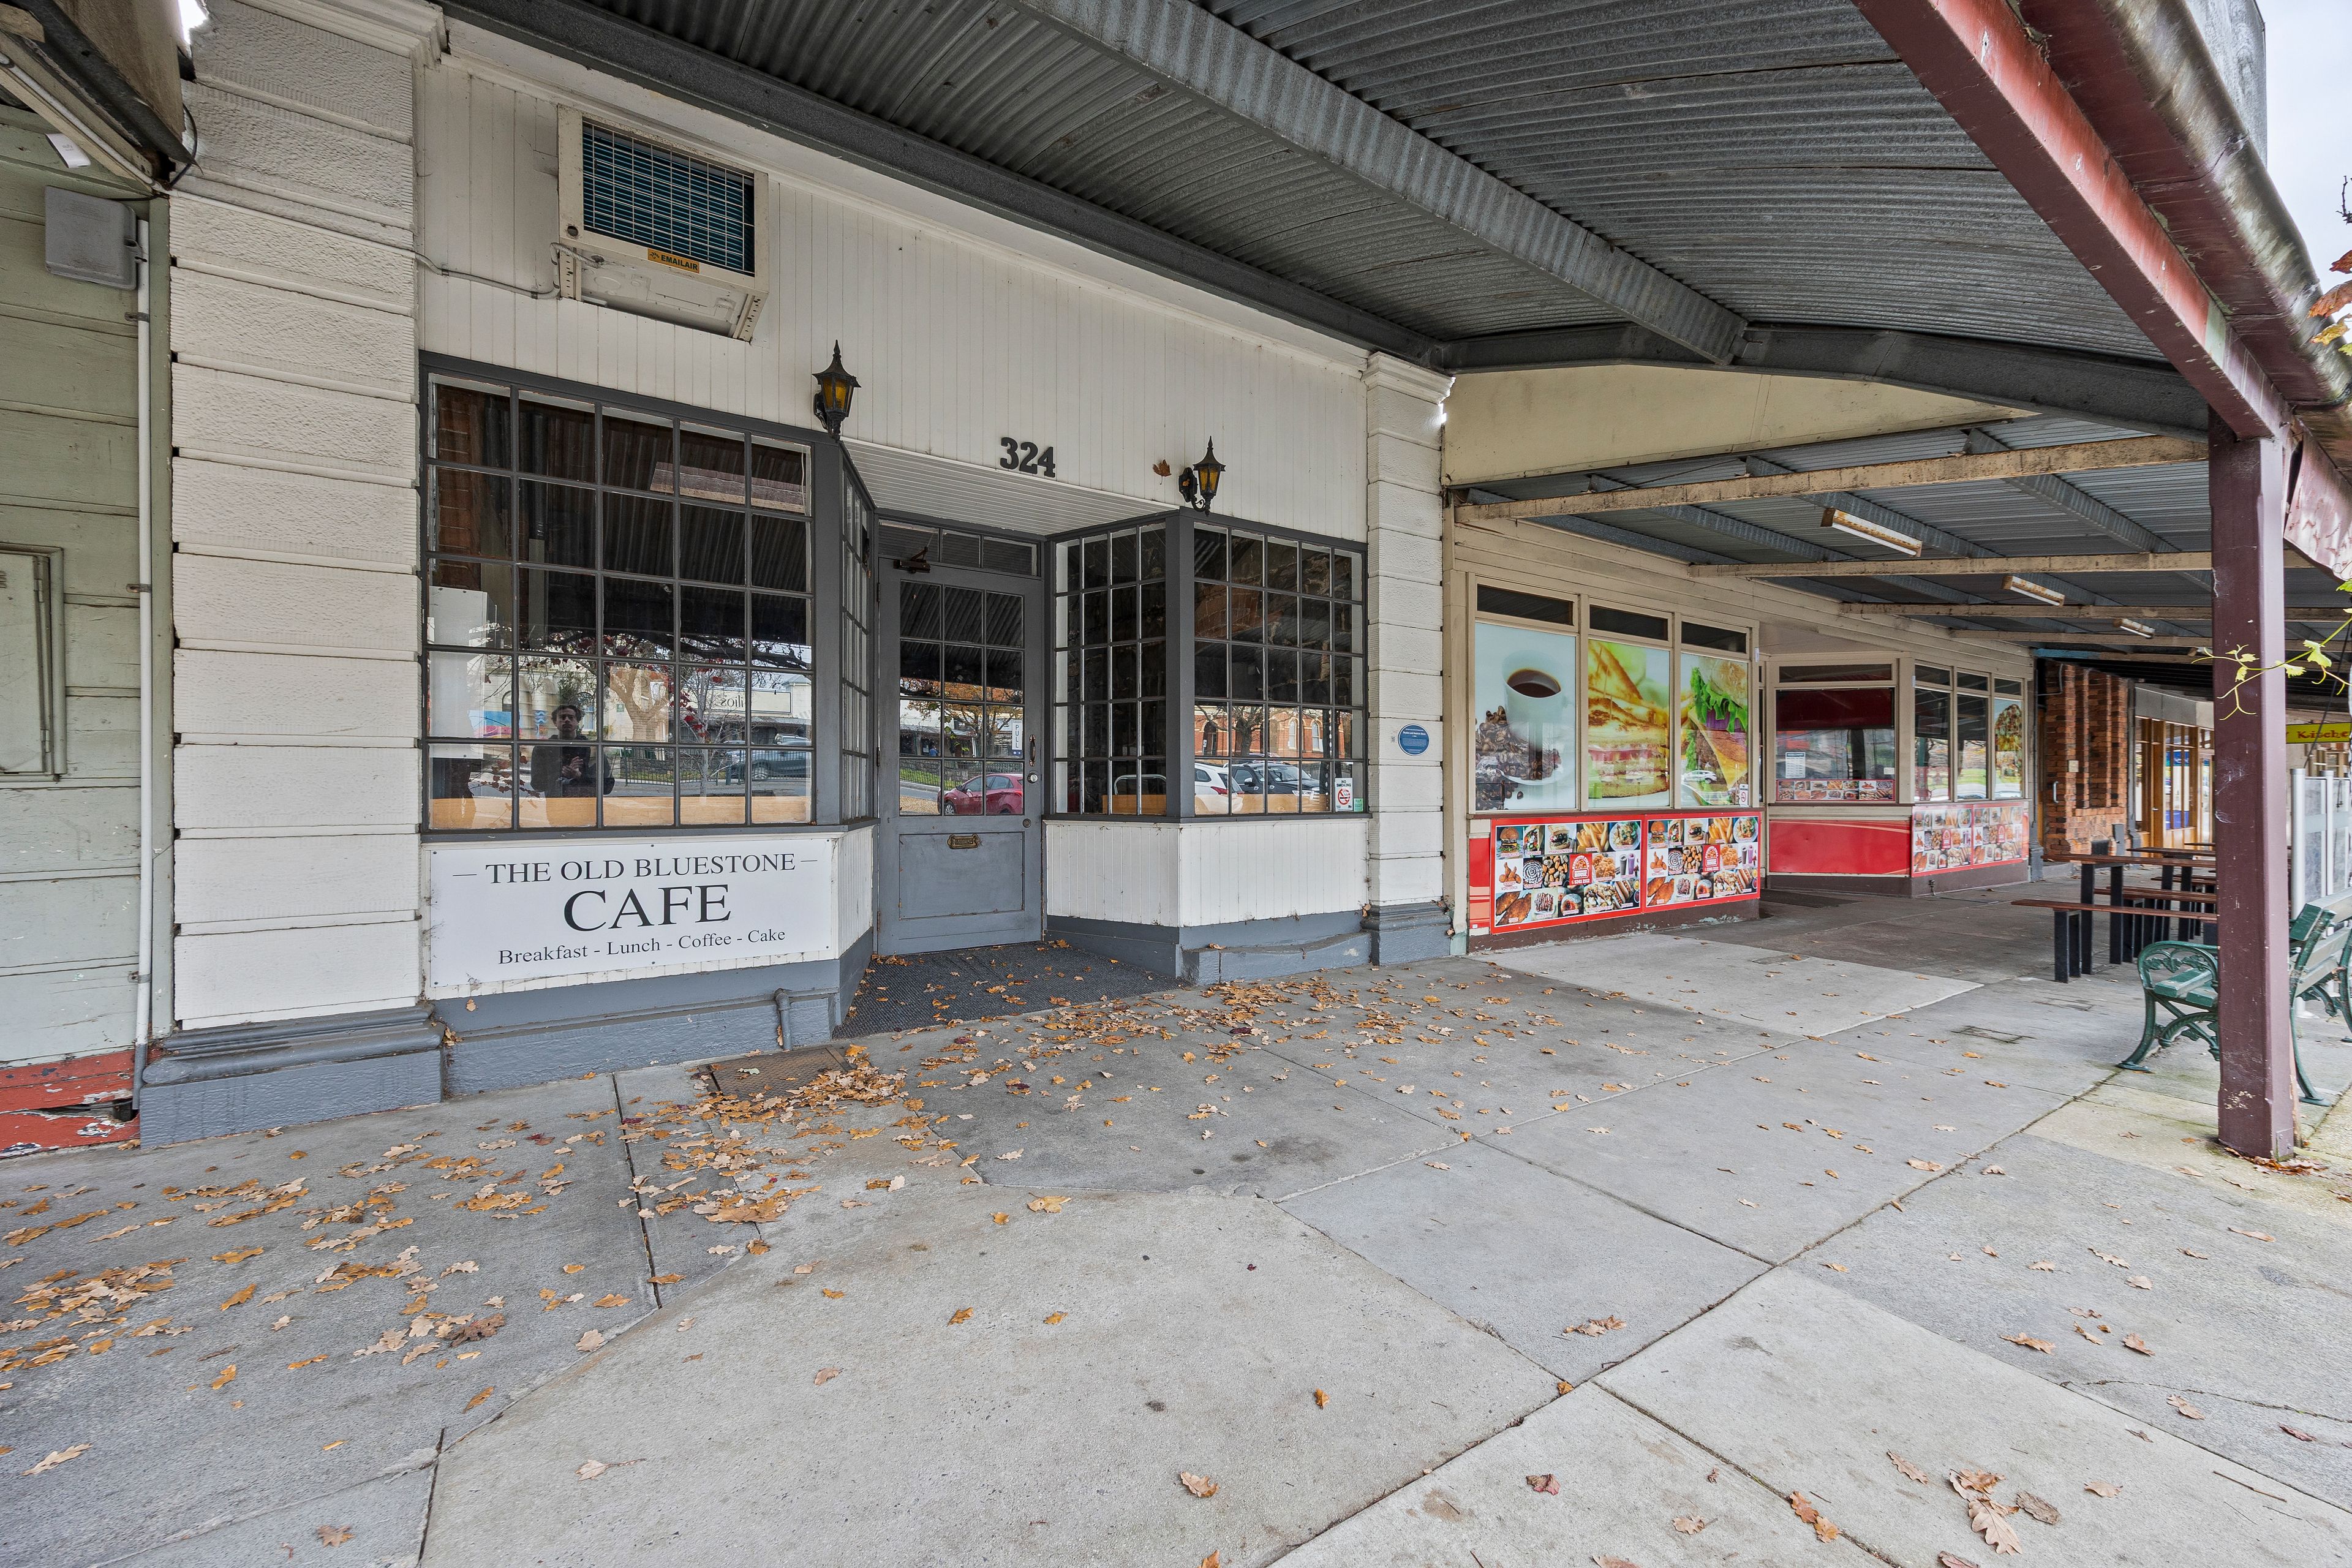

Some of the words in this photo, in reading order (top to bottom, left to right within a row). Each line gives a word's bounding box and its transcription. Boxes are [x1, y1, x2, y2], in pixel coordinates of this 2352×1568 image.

[662, 255, 698, 270] EMAILAIR
[1000, 437, 1055, 478] 324
[2297, 729, 2348, 739] Kitche
[486, 863, 551, 883] THE
[561, 861, 624, 880] OLD
[634, 854, 795, 877] BLUESTONE
[564, 884, 731, 931] CAFE
[499, 946, 587, 964] Breakfast
[608, 938, 660, 955] Lunch
[679, 933, 731, 948] Coffee
[748, 929, 785, 942] Cake
